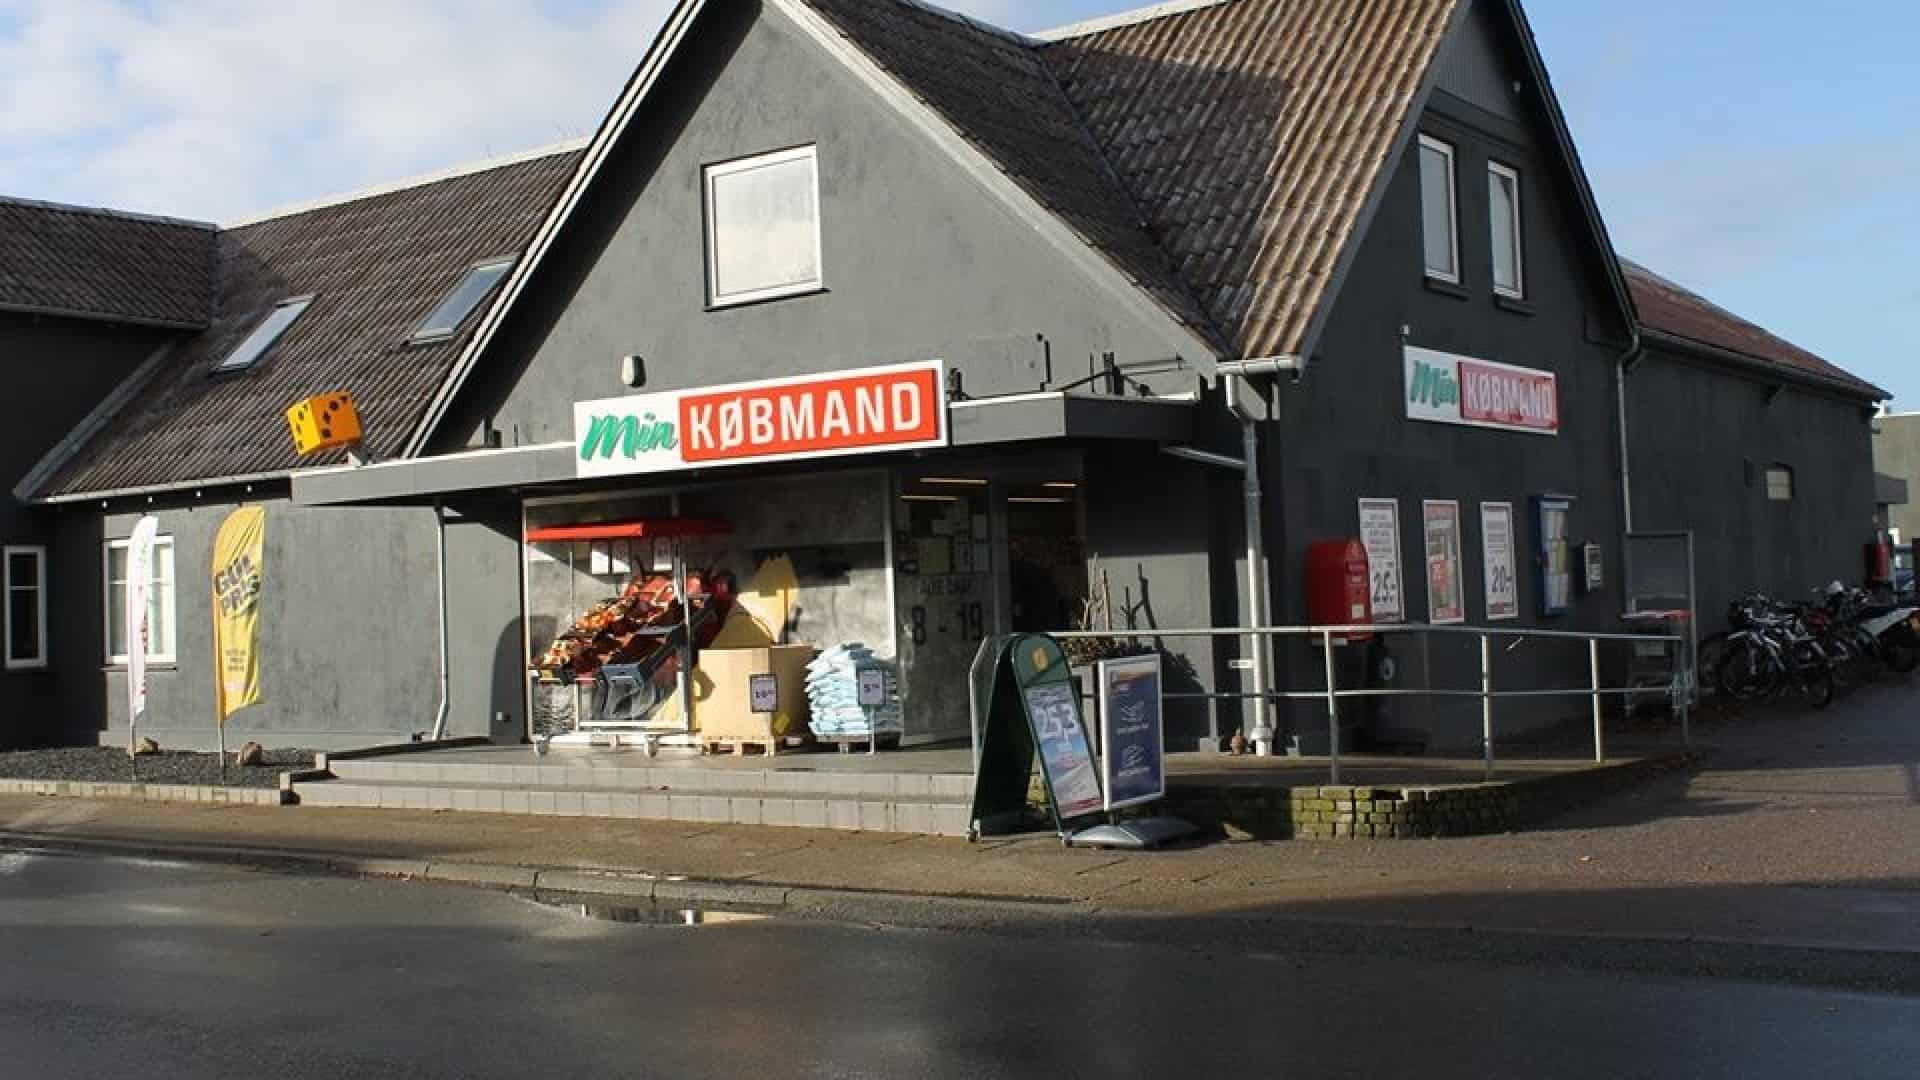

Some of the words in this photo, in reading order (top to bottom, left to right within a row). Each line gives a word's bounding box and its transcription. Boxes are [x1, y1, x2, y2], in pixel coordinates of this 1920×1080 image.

[1466, 372, 1553, 419] KØBMAND
[580, 412, 678, 461] Min
[689, 382, 921, 450] KØBMAND
[912, 604, 927, 646] 8
[957, 601, 983, 642] 19
